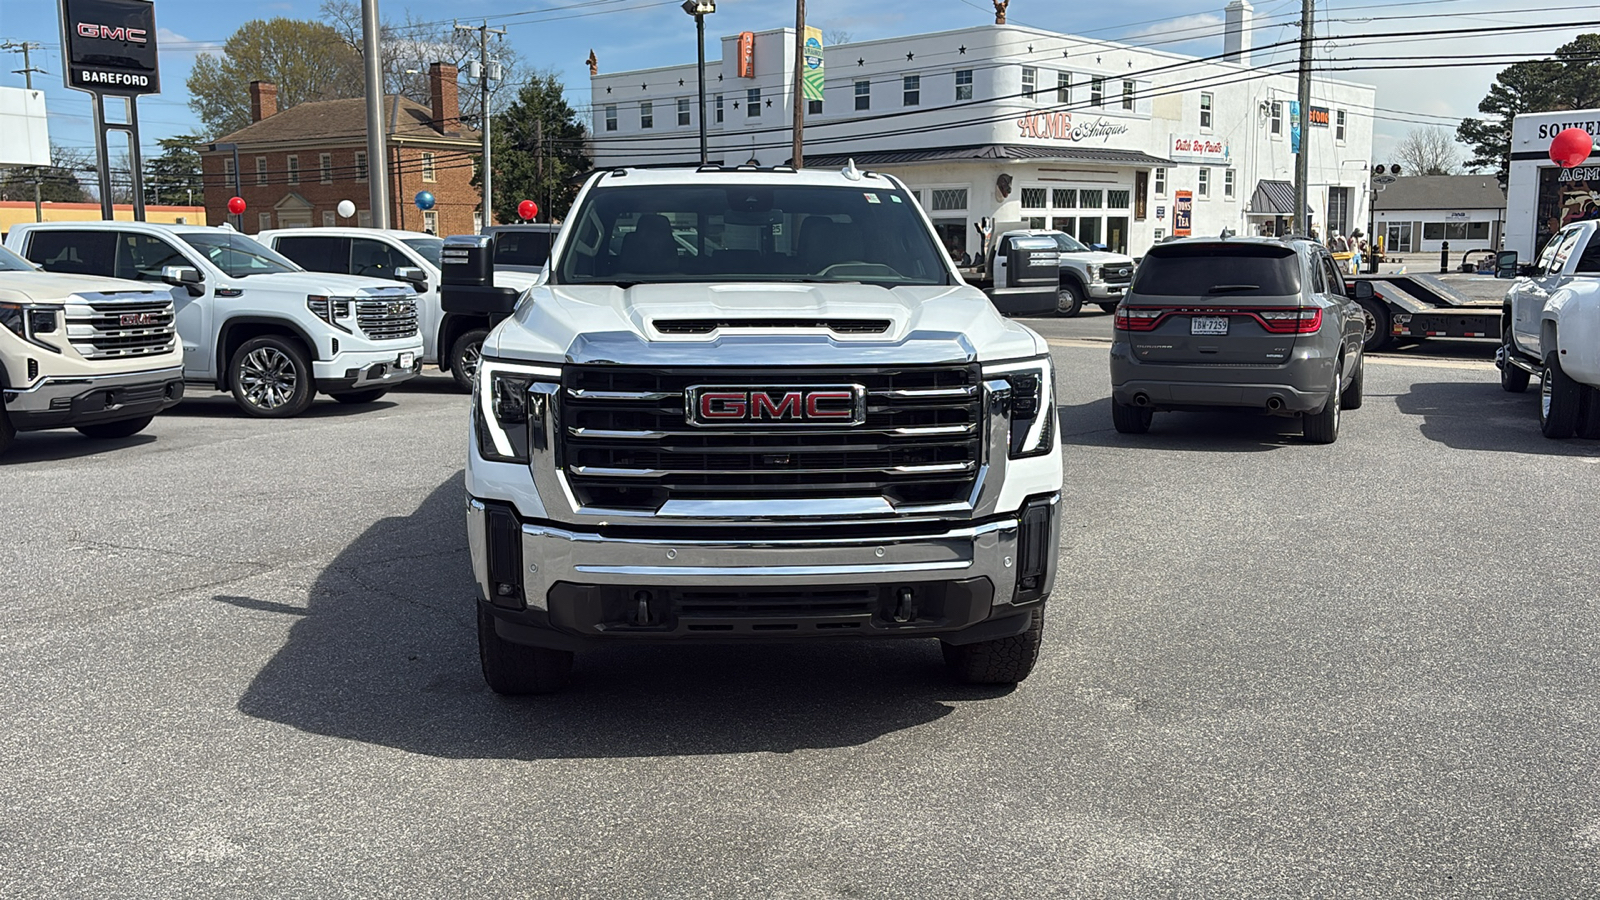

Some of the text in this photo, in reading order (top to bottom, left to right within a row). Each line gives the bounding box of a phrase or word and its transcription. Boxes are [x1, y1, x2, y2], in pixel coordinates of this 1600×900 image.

[77, 22, 147, 43] GMC
[82, 71, 149, 86] BAREFORD
[1017, 110, 1072, 140] ACME
[1083, 116, 1128, 143] Antiques
[1175, 139, 1222, 155] Dutch Boy Paints
[1177, 216, 1190, 227] TEA
[119, 314, 159, 327] GMC
[700, 391, 852, 420] GMC
